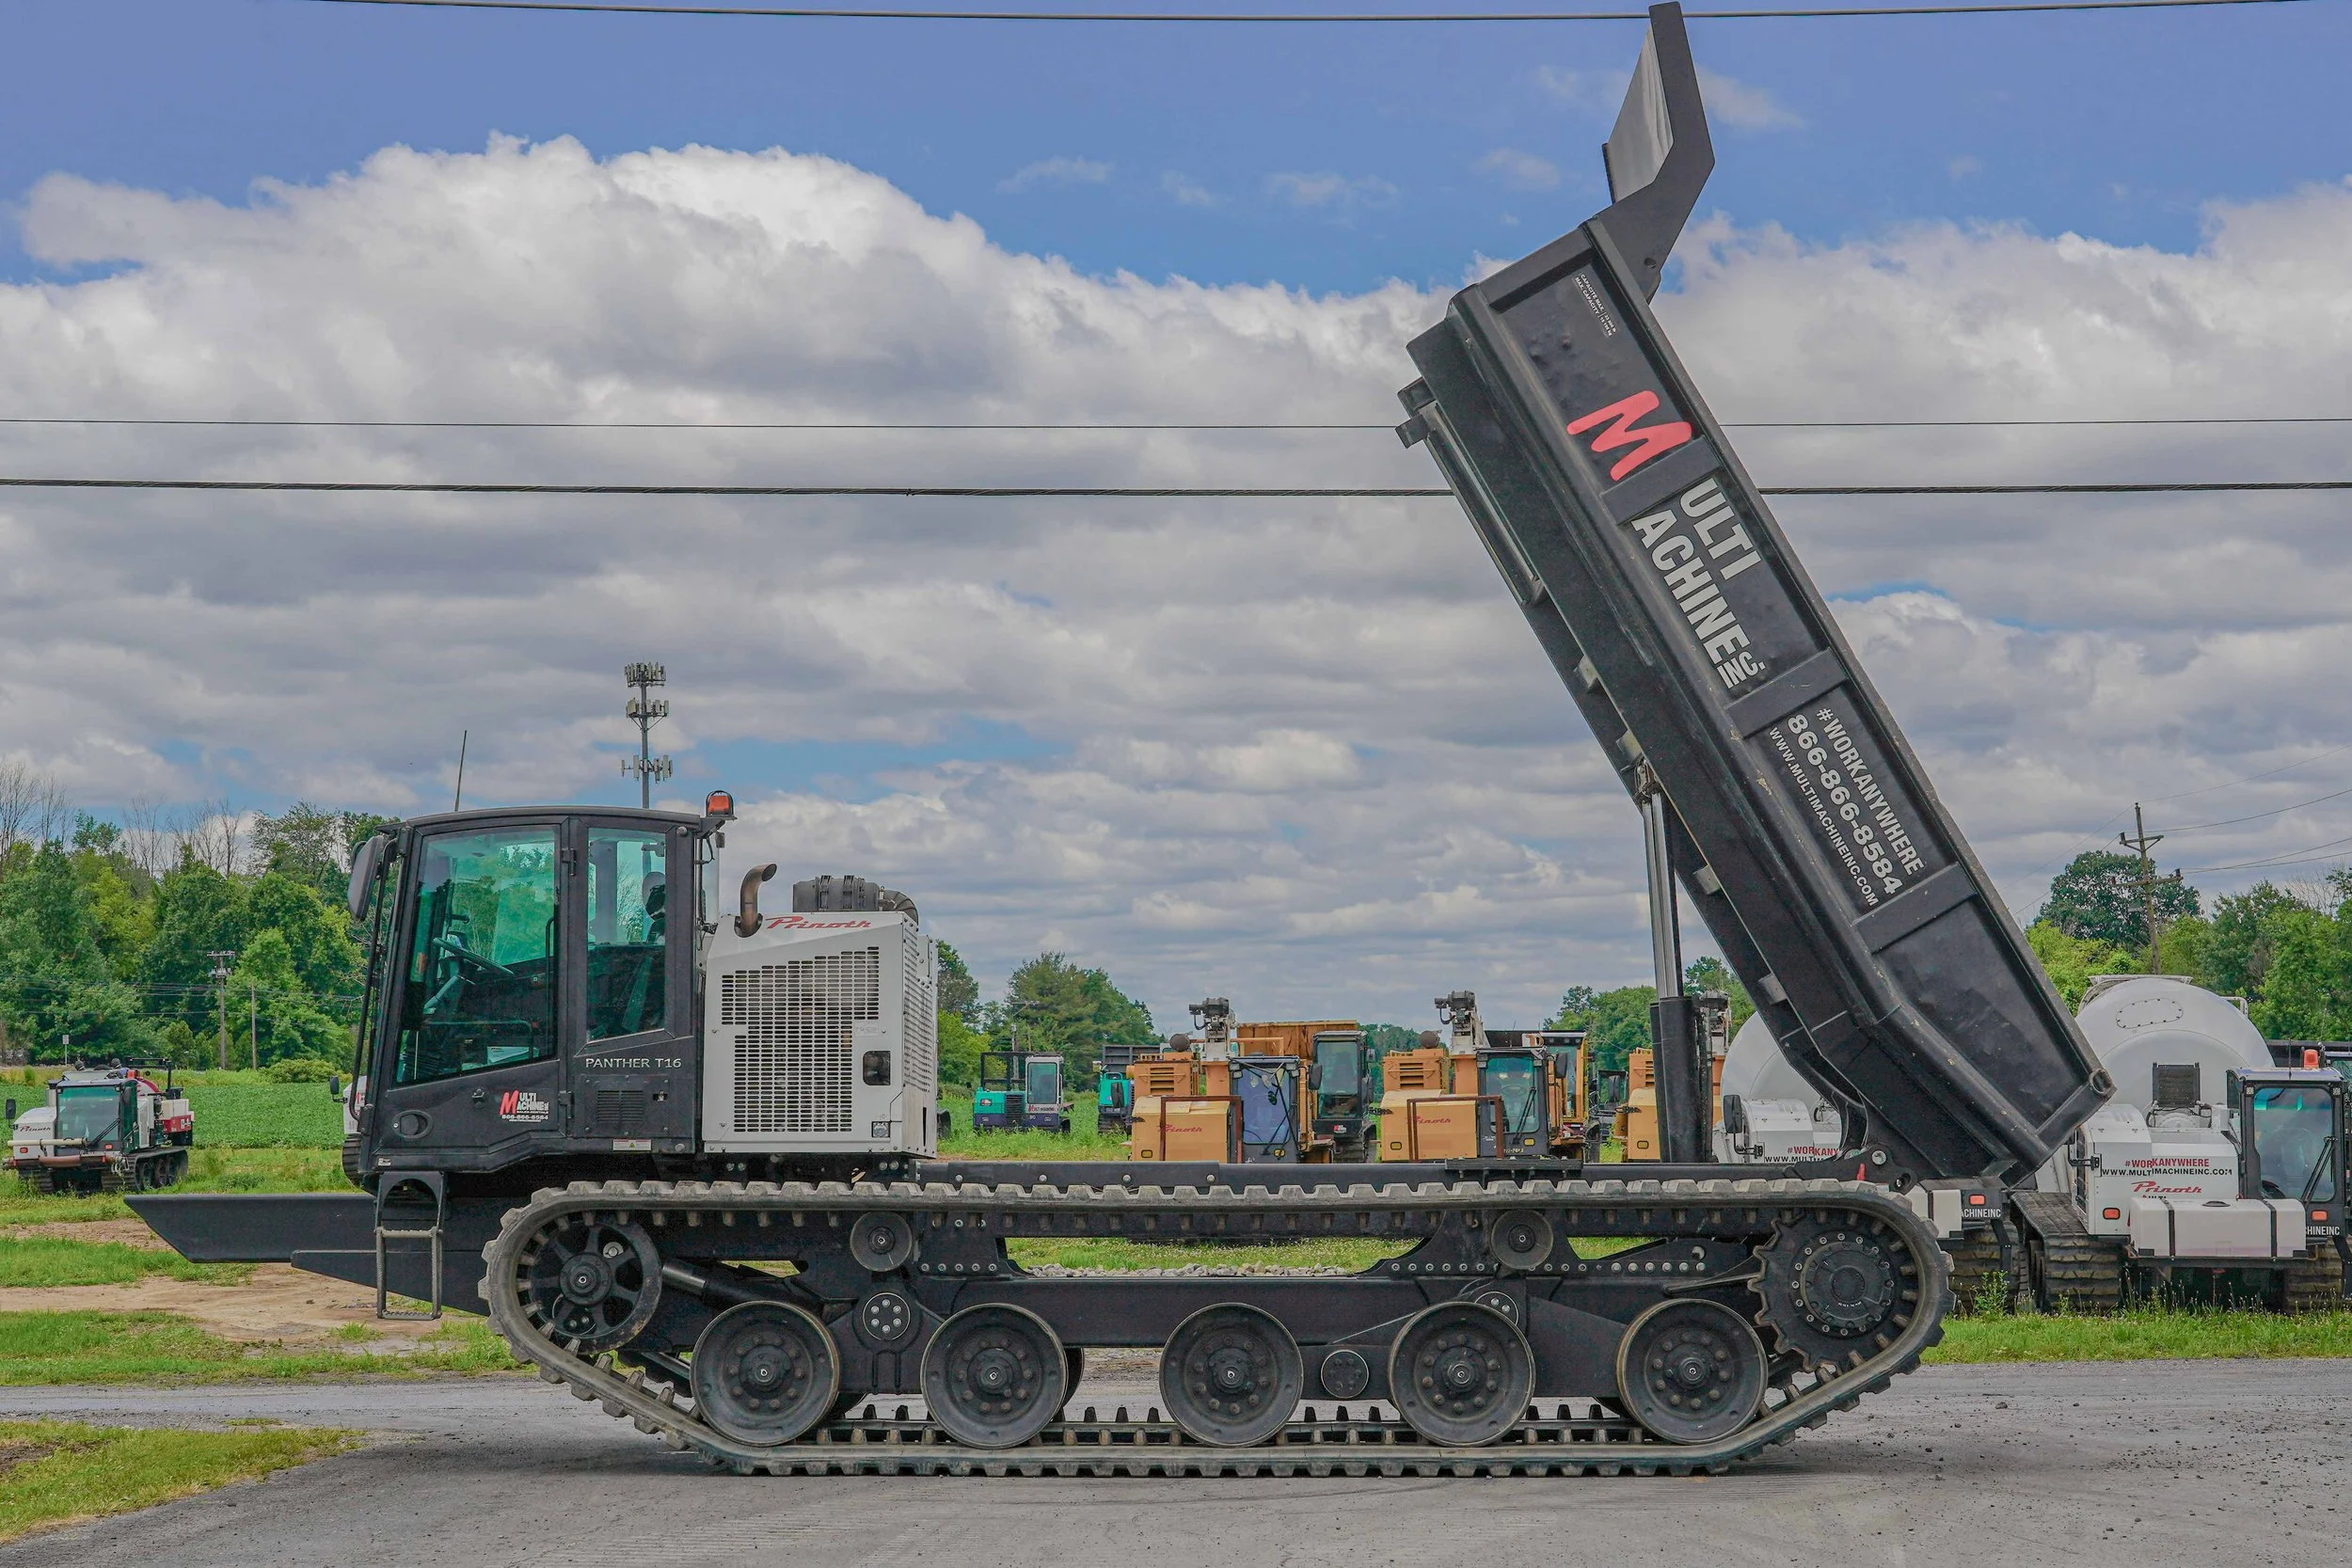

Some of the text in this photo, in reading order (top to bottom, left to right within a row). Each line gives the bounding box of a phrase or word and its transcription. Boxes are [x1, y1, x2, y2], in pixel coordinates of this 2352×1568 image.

[1575, 277, 1584, 291] MAX.
[1582, 290, 1599, 314] CAPACITY
[1716, 650, 1767, 689] INC.
[1816, 707, 1925, 876] #WORKANYWHERE
[1769, 727, 1880, 907] WWW.MULTIMACHINEINC.COM
[1788, 714, 1903, 895] 866-866-8584
[766, 915, 871, 929] Prinoth
[585, 1058, 682, 1069] PANTHER T16
[2124, 1158, 2209, 1168] #WORKANYWHERE
[2131, 1180, 2202, 1194] Prinoth
[2306, 1226, 2340, 1236] HINEINC
